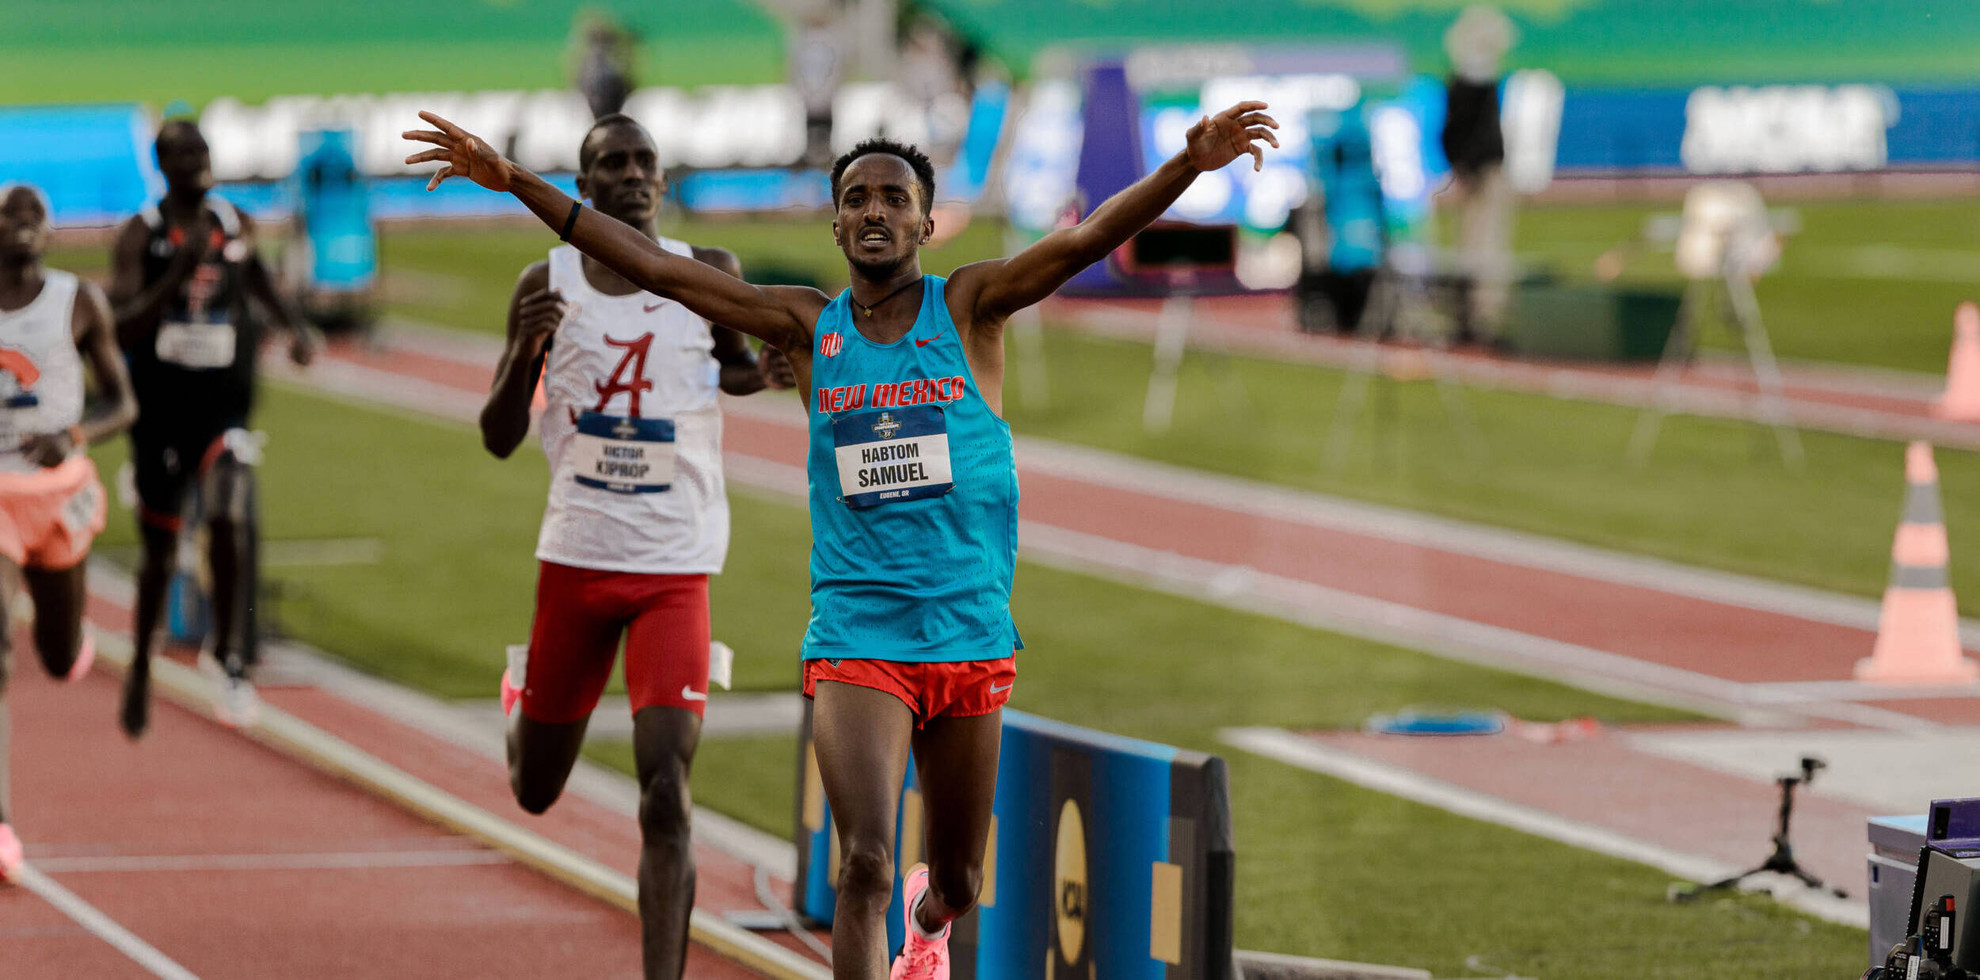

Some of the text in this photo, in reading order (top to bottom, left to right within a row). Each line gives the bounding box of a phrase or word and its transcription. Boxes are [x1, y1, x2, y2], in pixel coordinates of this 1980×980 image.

[594, 331, 655, 418] A
[818, 376, 965, 414] NEW MEXICO
[861, 443, 919, 464] HABTOM
[858, 462, 929, 488] SAMUEL
